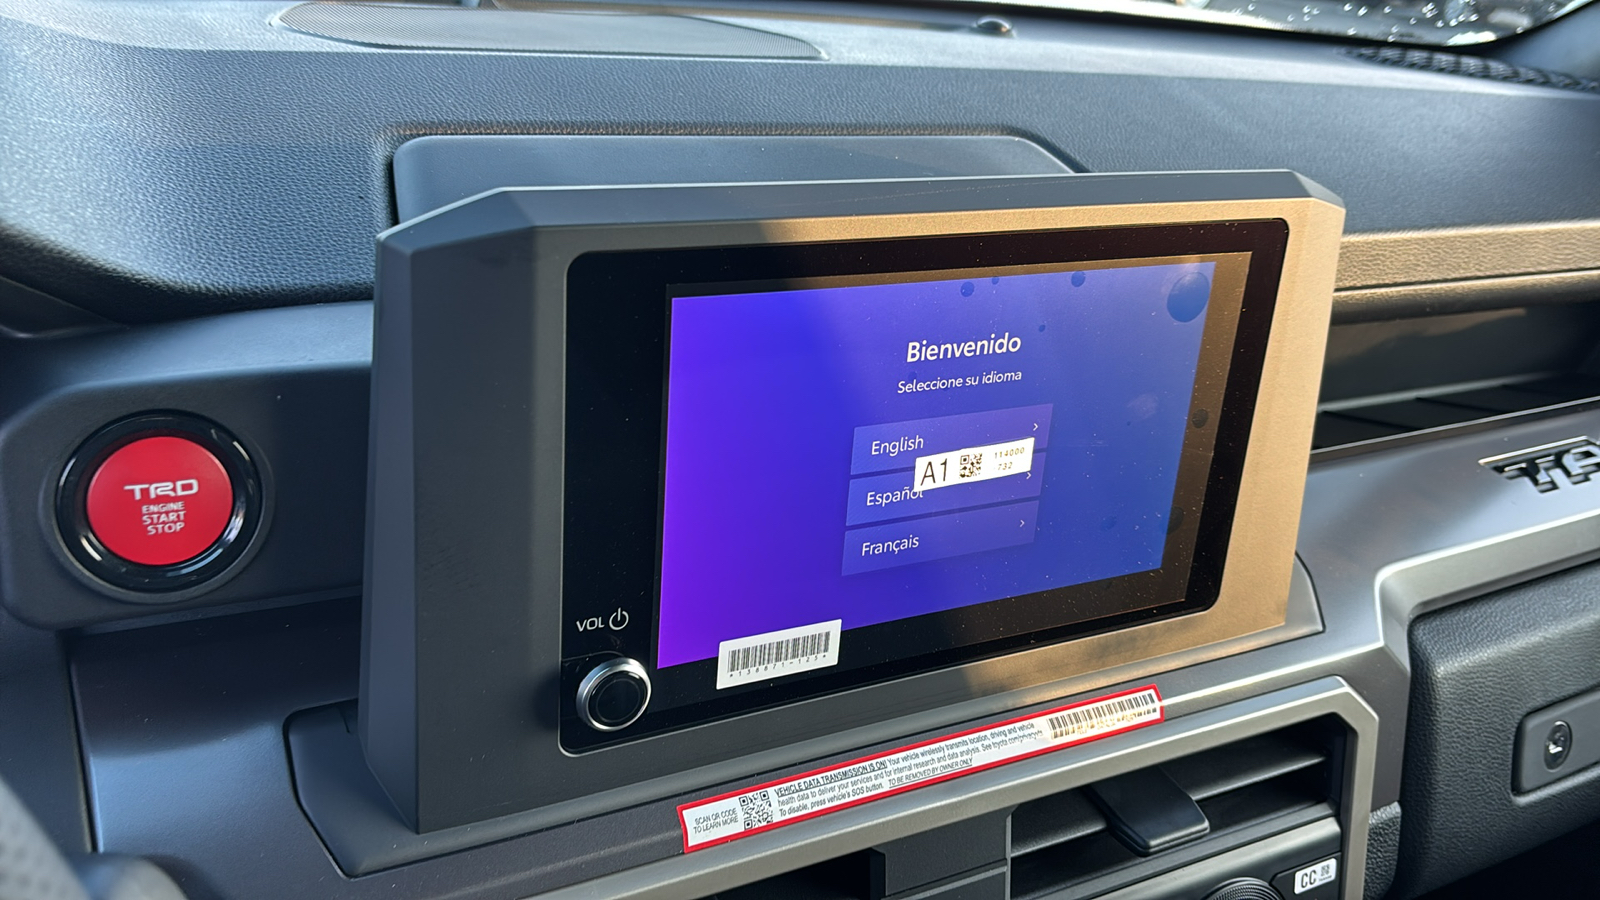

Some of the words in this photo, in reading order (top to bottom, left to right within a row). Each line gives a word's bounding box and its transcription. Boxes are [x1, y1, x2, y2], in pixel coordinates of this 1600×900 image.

[906, 332, 1022, 363] Bienvenido
[897, 376, 963, 394] Seleccione
[965, 375, 979, 386] su
[982, 370, 1022, 385] idioma
[871, 434, 924, 457] English
[920, 458, 948, 486] A1
[123, 478, 199, 501] TRD
[141, 501, 185, 514] ENGINE
[142, 511, 187, 525] START
[147, 522, 185, 536] STOP
[861, 534, 920, 556] Français
[575, 616, 605, 632] VOL
[774, 781, 804, 797] VEHICLE
[803, 777, 821, 790] DATA
[820, 763, 868, 784] TRANSMISSION
[868, 762, 875, 772] IS
[887, 757, 900, 766] Your
[901, 752, 920, 763] vehicle
[920, 743, 945, 757] wirelessly
[945, 739, 969, 751] transmits
[968, 734, 990, 745] location,
[990, 729, 1007, 740] driving
[1007, 725, 1017, 735] and
[1017, 722, 1035, 732] vehicle
[777, 796, 796, 808] health
[796, 792, 810, 802] data
[810, 789, 816, 798] to
[818, 784, 836, 796] deliver
[837, 781, 850, 792] your
[850, 775, 873, 787] services
[874, 771, 884, 781] and
[884, 768, 892, 778] for
[892, 763, 912, 776] internal
[913, 758, 936, 770] research
[937, 754, 947, 764] and
[947, 751, 959, 761] data
[981, 742, 993, 752] See
[779, 808, 787, 817] To
[787, 803, 810, 815] disable,
[810, 798, 826, 810] press
[827, 791, 851, 804] vehicle's
[851, 786, 865, 797] SOS
[865, 782, 884, 793] button.
[888, 778, 896, 786] TO
[896, 776, 904, 784] BE
[904, 768, 931, 781] REMOVED
[931, 766, 940, 775] BY
[939, 761, 959, 772] OWNER
[959, 757, 973, 767] ONLY
[693, 826, 702, 834] TO
[702, 821, 721, 832] LEARN
[721, 815, 739, 826] MORE
[694, 814, 711, 826] SCAN
[720, 807, 738, 817] CODE
[1300, 869, 1317, 889] CC
